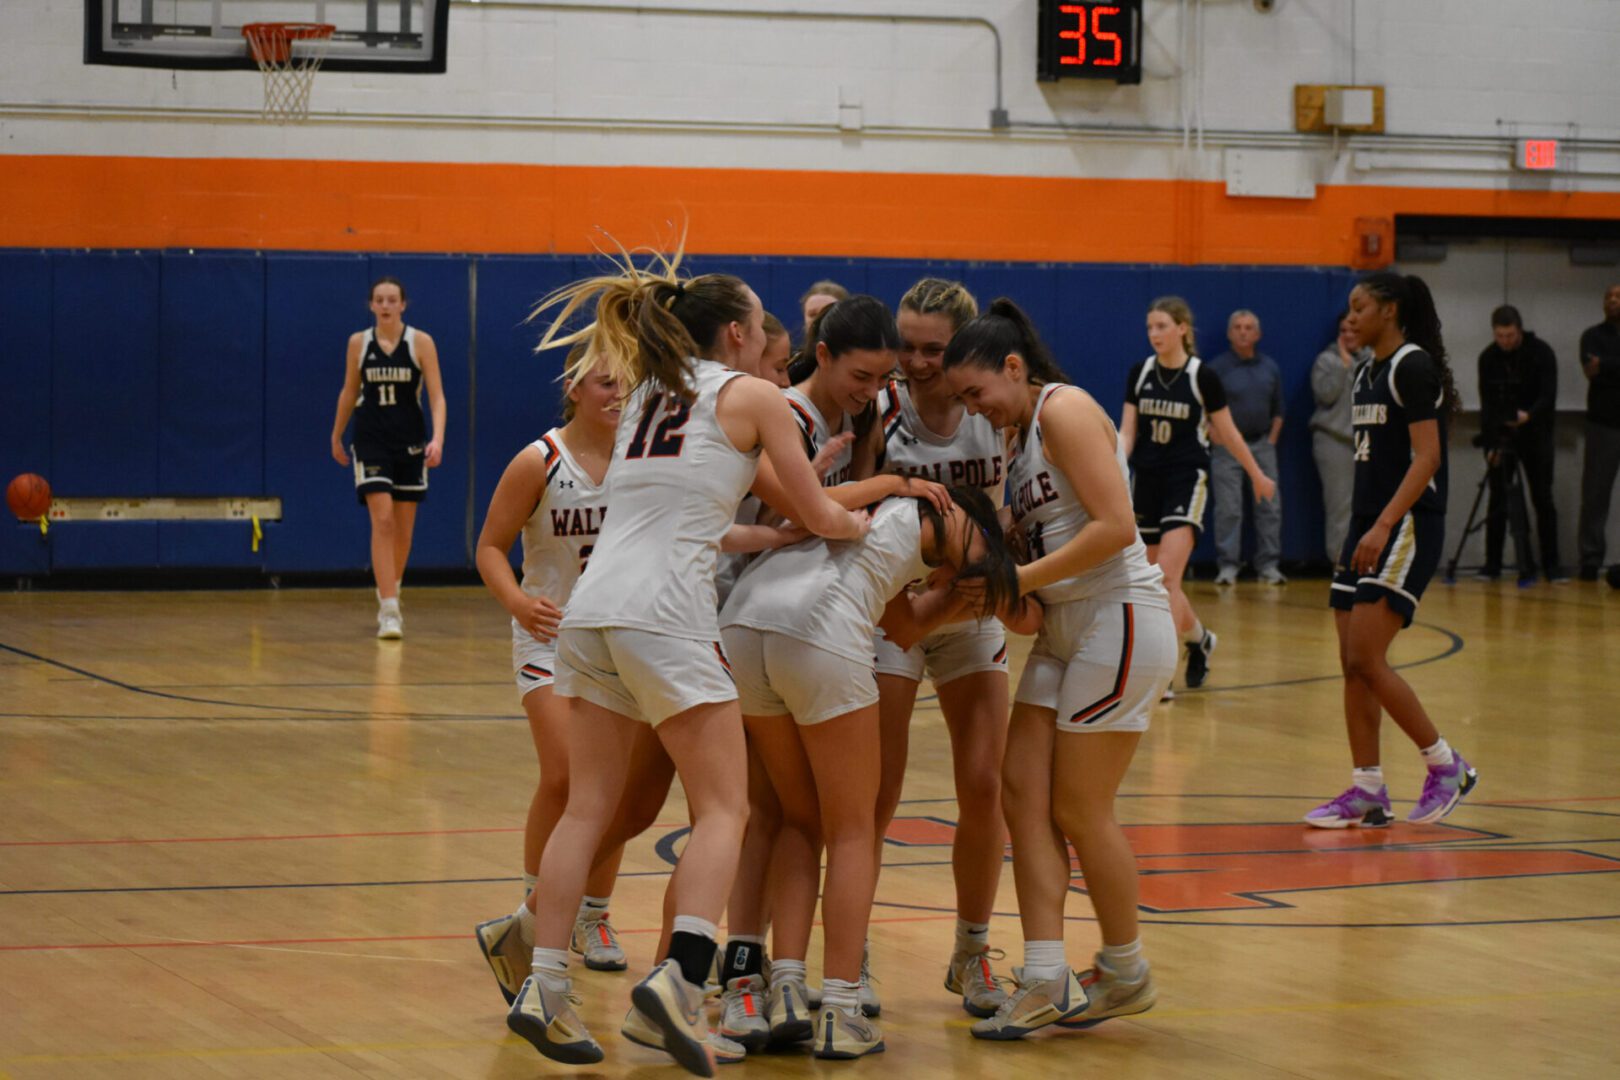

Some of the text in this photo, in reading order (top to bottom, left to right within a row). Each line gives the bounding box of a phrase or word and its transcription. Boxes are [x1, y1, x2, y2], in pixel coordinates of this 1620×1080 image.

[1058, 4, 1123, 66] 35
[365, 366, 412, 382] WILLIAMS
[377, 383, 397, 406] 11
[1139, 398, 1190, 420] WILLIAMS
[625, 391, 691, 460] 12
[1149, 418, 1172, 445] 10
[895, 455, 1002, 488] ALPOLE
